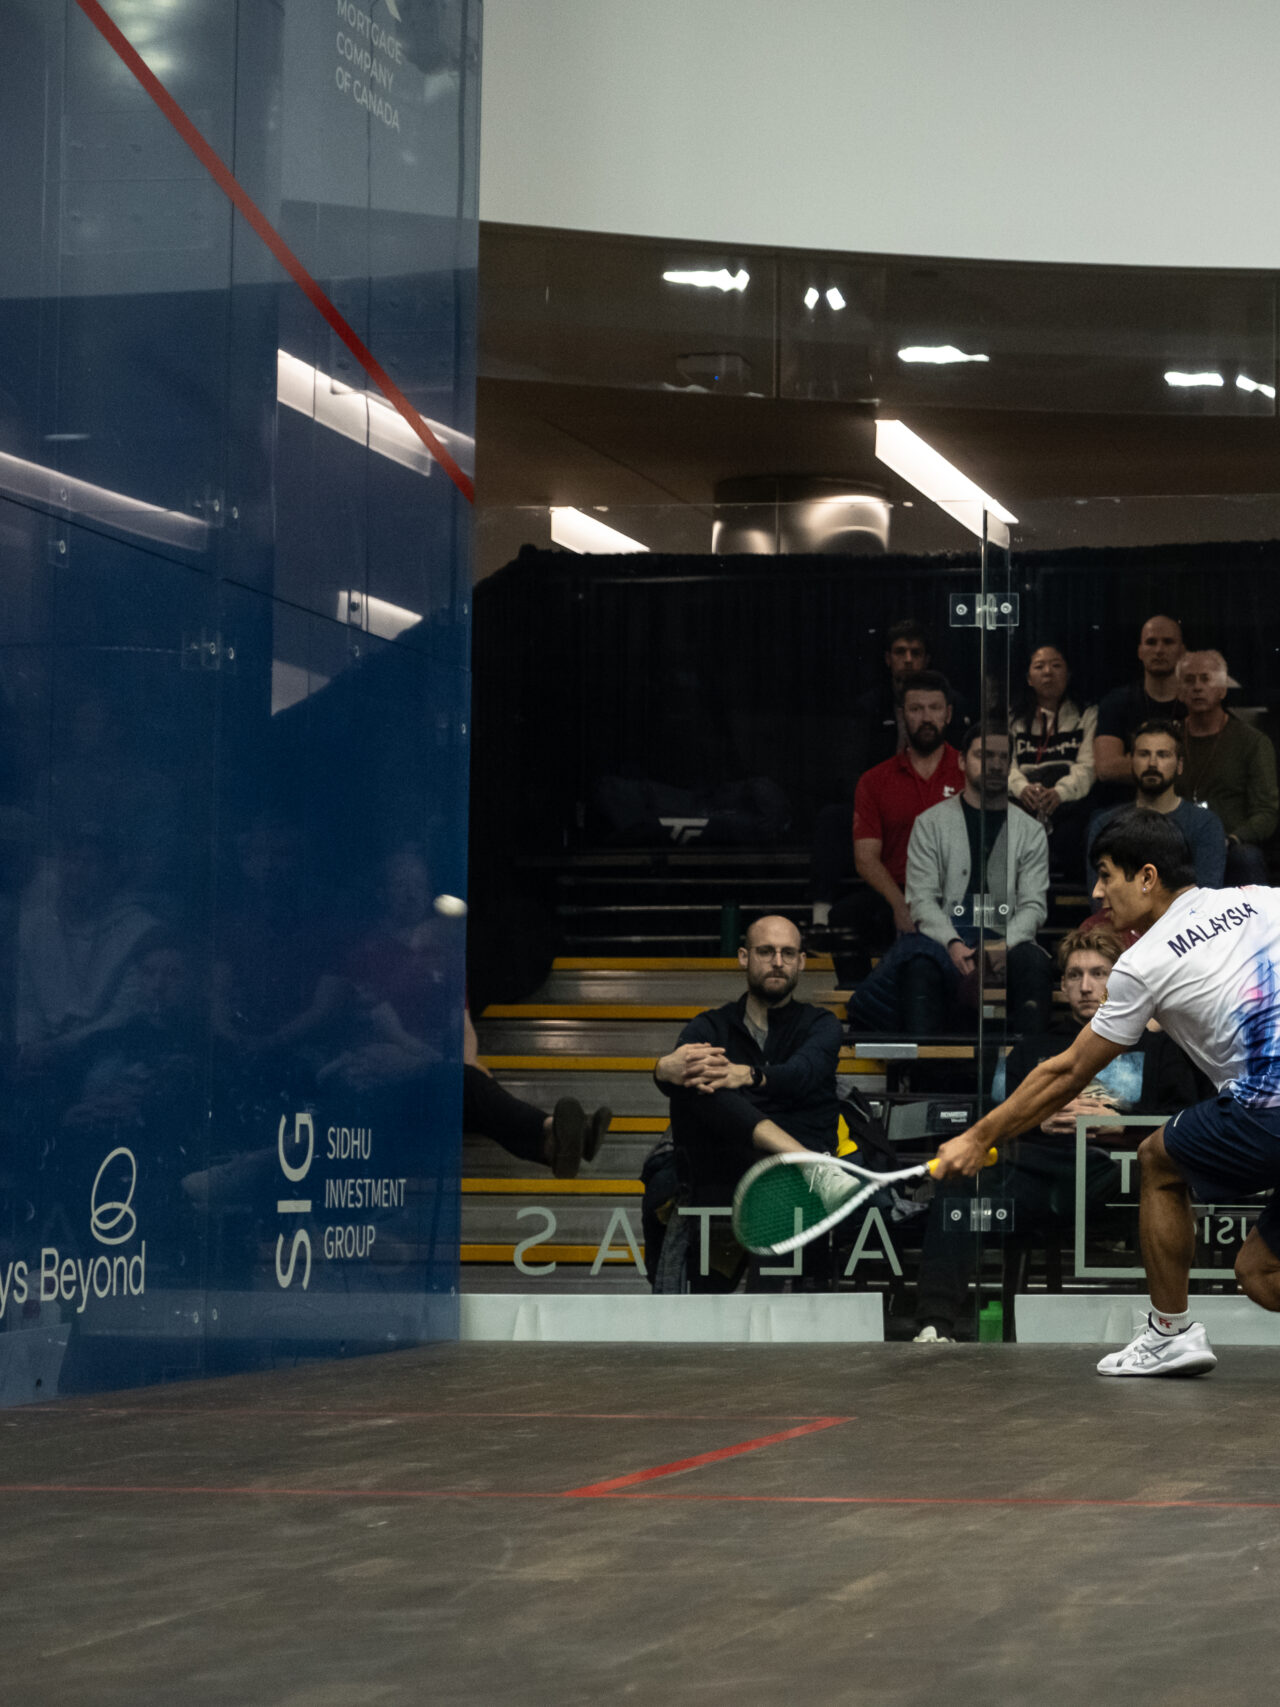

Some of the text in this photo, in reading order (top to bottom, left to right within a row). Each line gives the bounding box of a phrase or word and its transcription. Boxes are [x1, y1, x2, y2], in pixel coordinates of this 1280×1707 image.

[337, 0, 402, 64] MORTGAGE
[336, 32, 394, 92] COMPANY
[335, 66, 400, 133] OF CANADA
[1167, 902, 1258, 958] MALAYSIA
[327, 1127, 372, 1160] SIDHU
[325, 1178, 407, 1209] INVESTMENT
[323, 1225, 376, 1259] GROUP
[41, 1240, 145, 1313] Beyond
